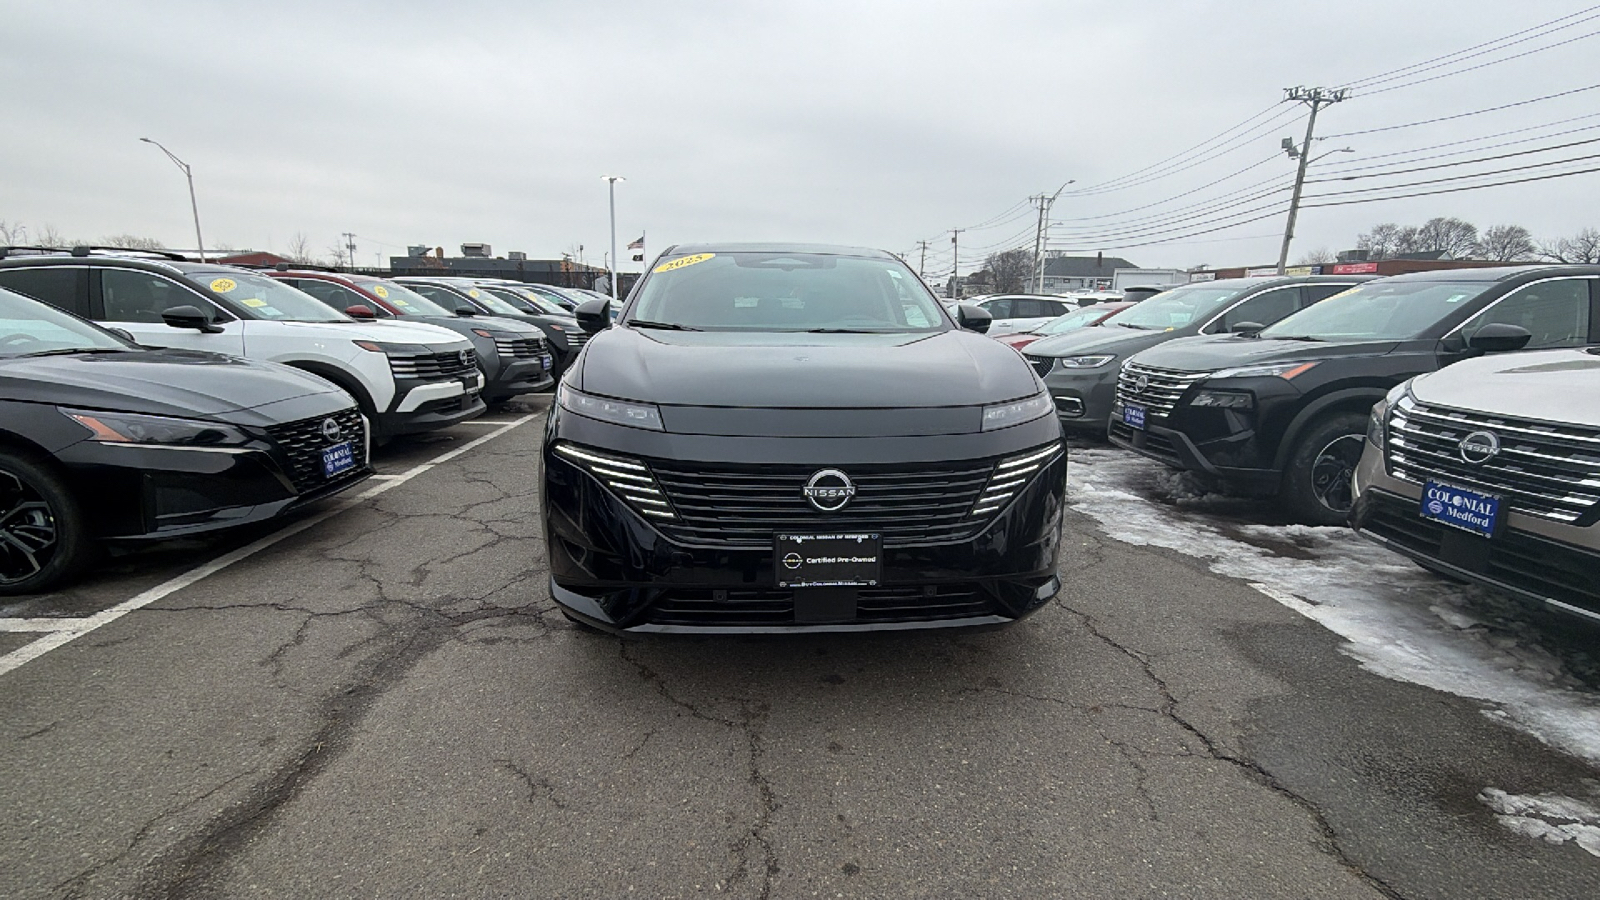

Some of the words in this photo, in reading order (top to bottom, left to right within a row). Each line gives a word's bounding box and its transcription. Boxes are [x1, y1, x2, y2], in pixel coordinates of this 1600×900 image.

[666, 255, 703, 270] 2025
[804, 488, 855, 497] NISSAN
[1428, 488, 1493, 516] COLONIAL
[1447, 507, 1489, 527] Medford
